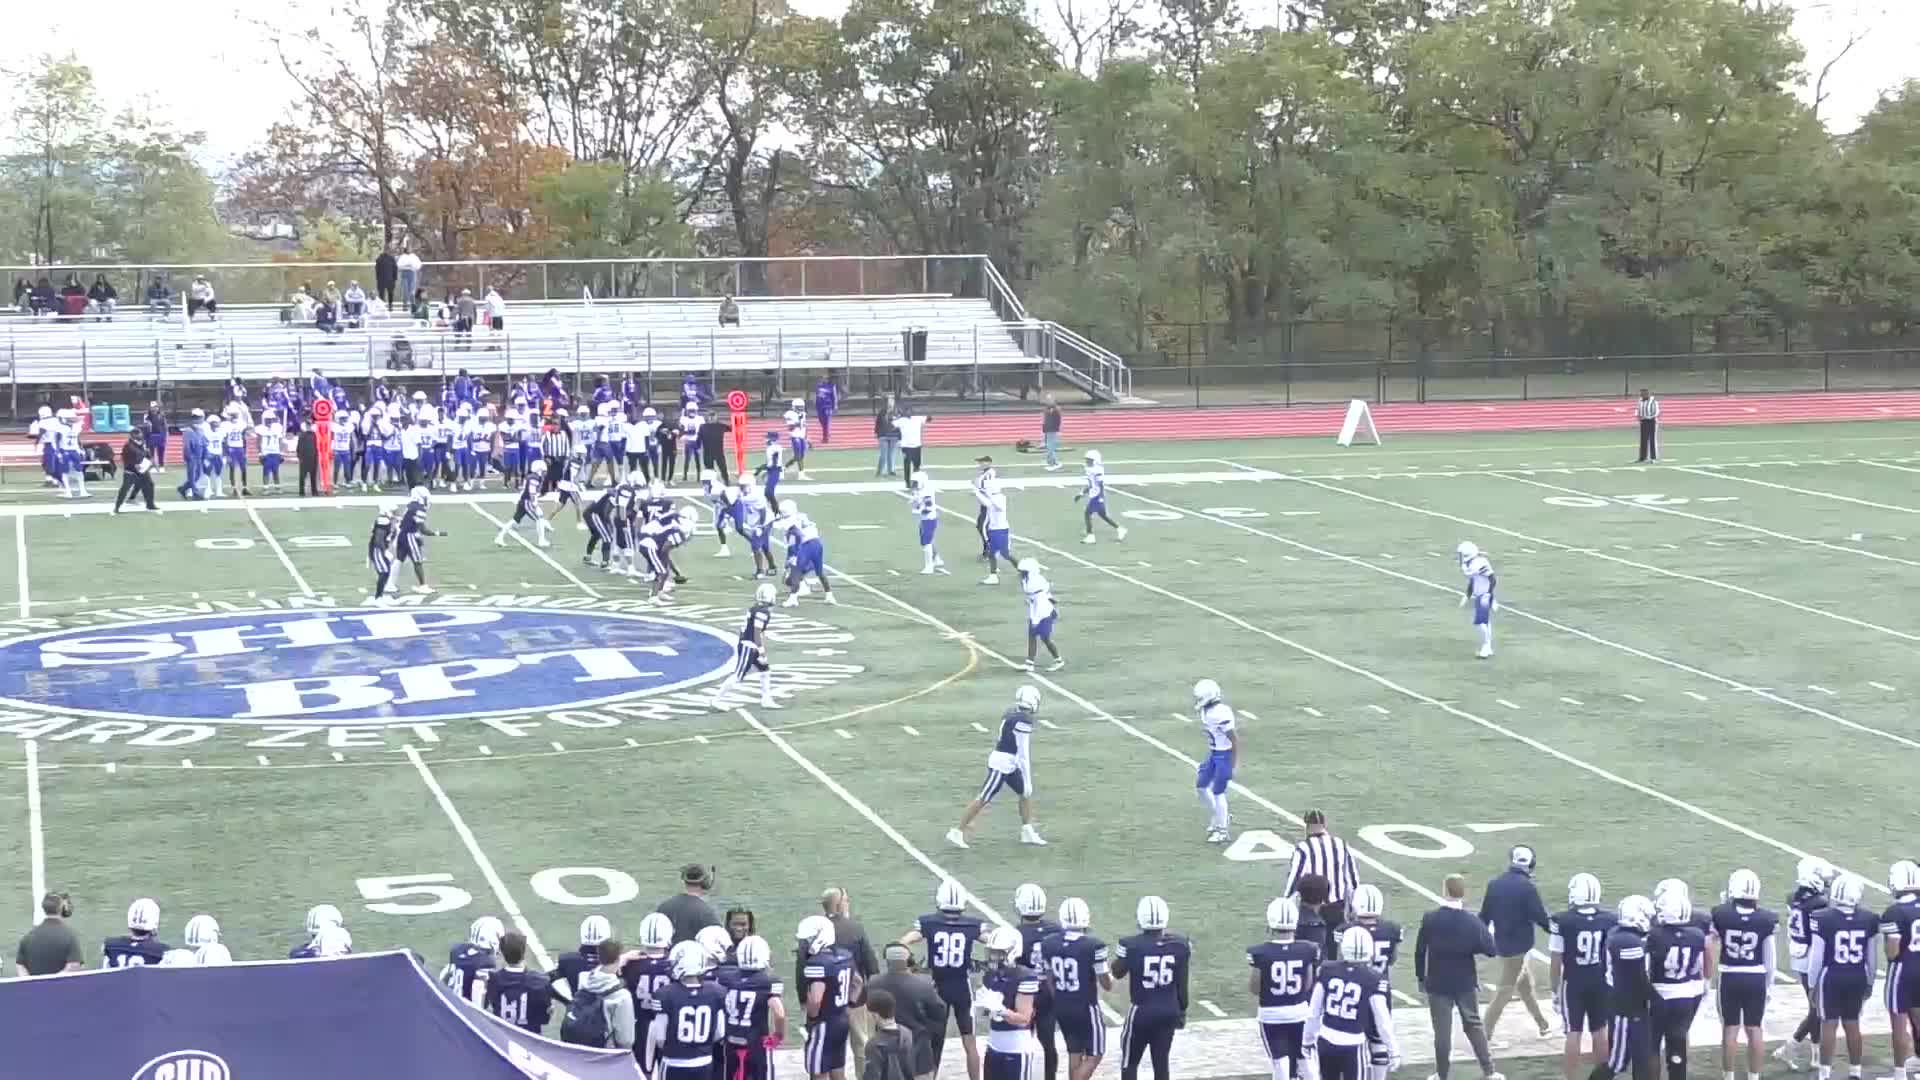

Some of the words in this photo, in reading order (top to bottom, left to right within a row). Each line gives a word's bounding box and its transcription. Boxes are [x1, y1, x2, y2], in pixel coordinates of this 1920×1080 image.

[75, 595, 337, 621] TEVLIN
[39, 610, 504, 667] SHP
[223, 646, 680, 718] BPT
[246, 722, 447, 747] ZET
[355, 866, 640, 916] 50
[933, 931, 967, 968] 38
[1575, 930, 1602, 966] 91
[1725, 929, 1759, 961] 52
[1834, 930, 1865, 964] 65
[1051, 956, 1080, 992] 93
[1142, 954, 1176, 989] 56
[1270, 959, 1303, 996] 95
[725, 989, 757, 1027] 47
[1325, 977, 1362, 1020] 22
[677, 1004, 712, 1044] 60
